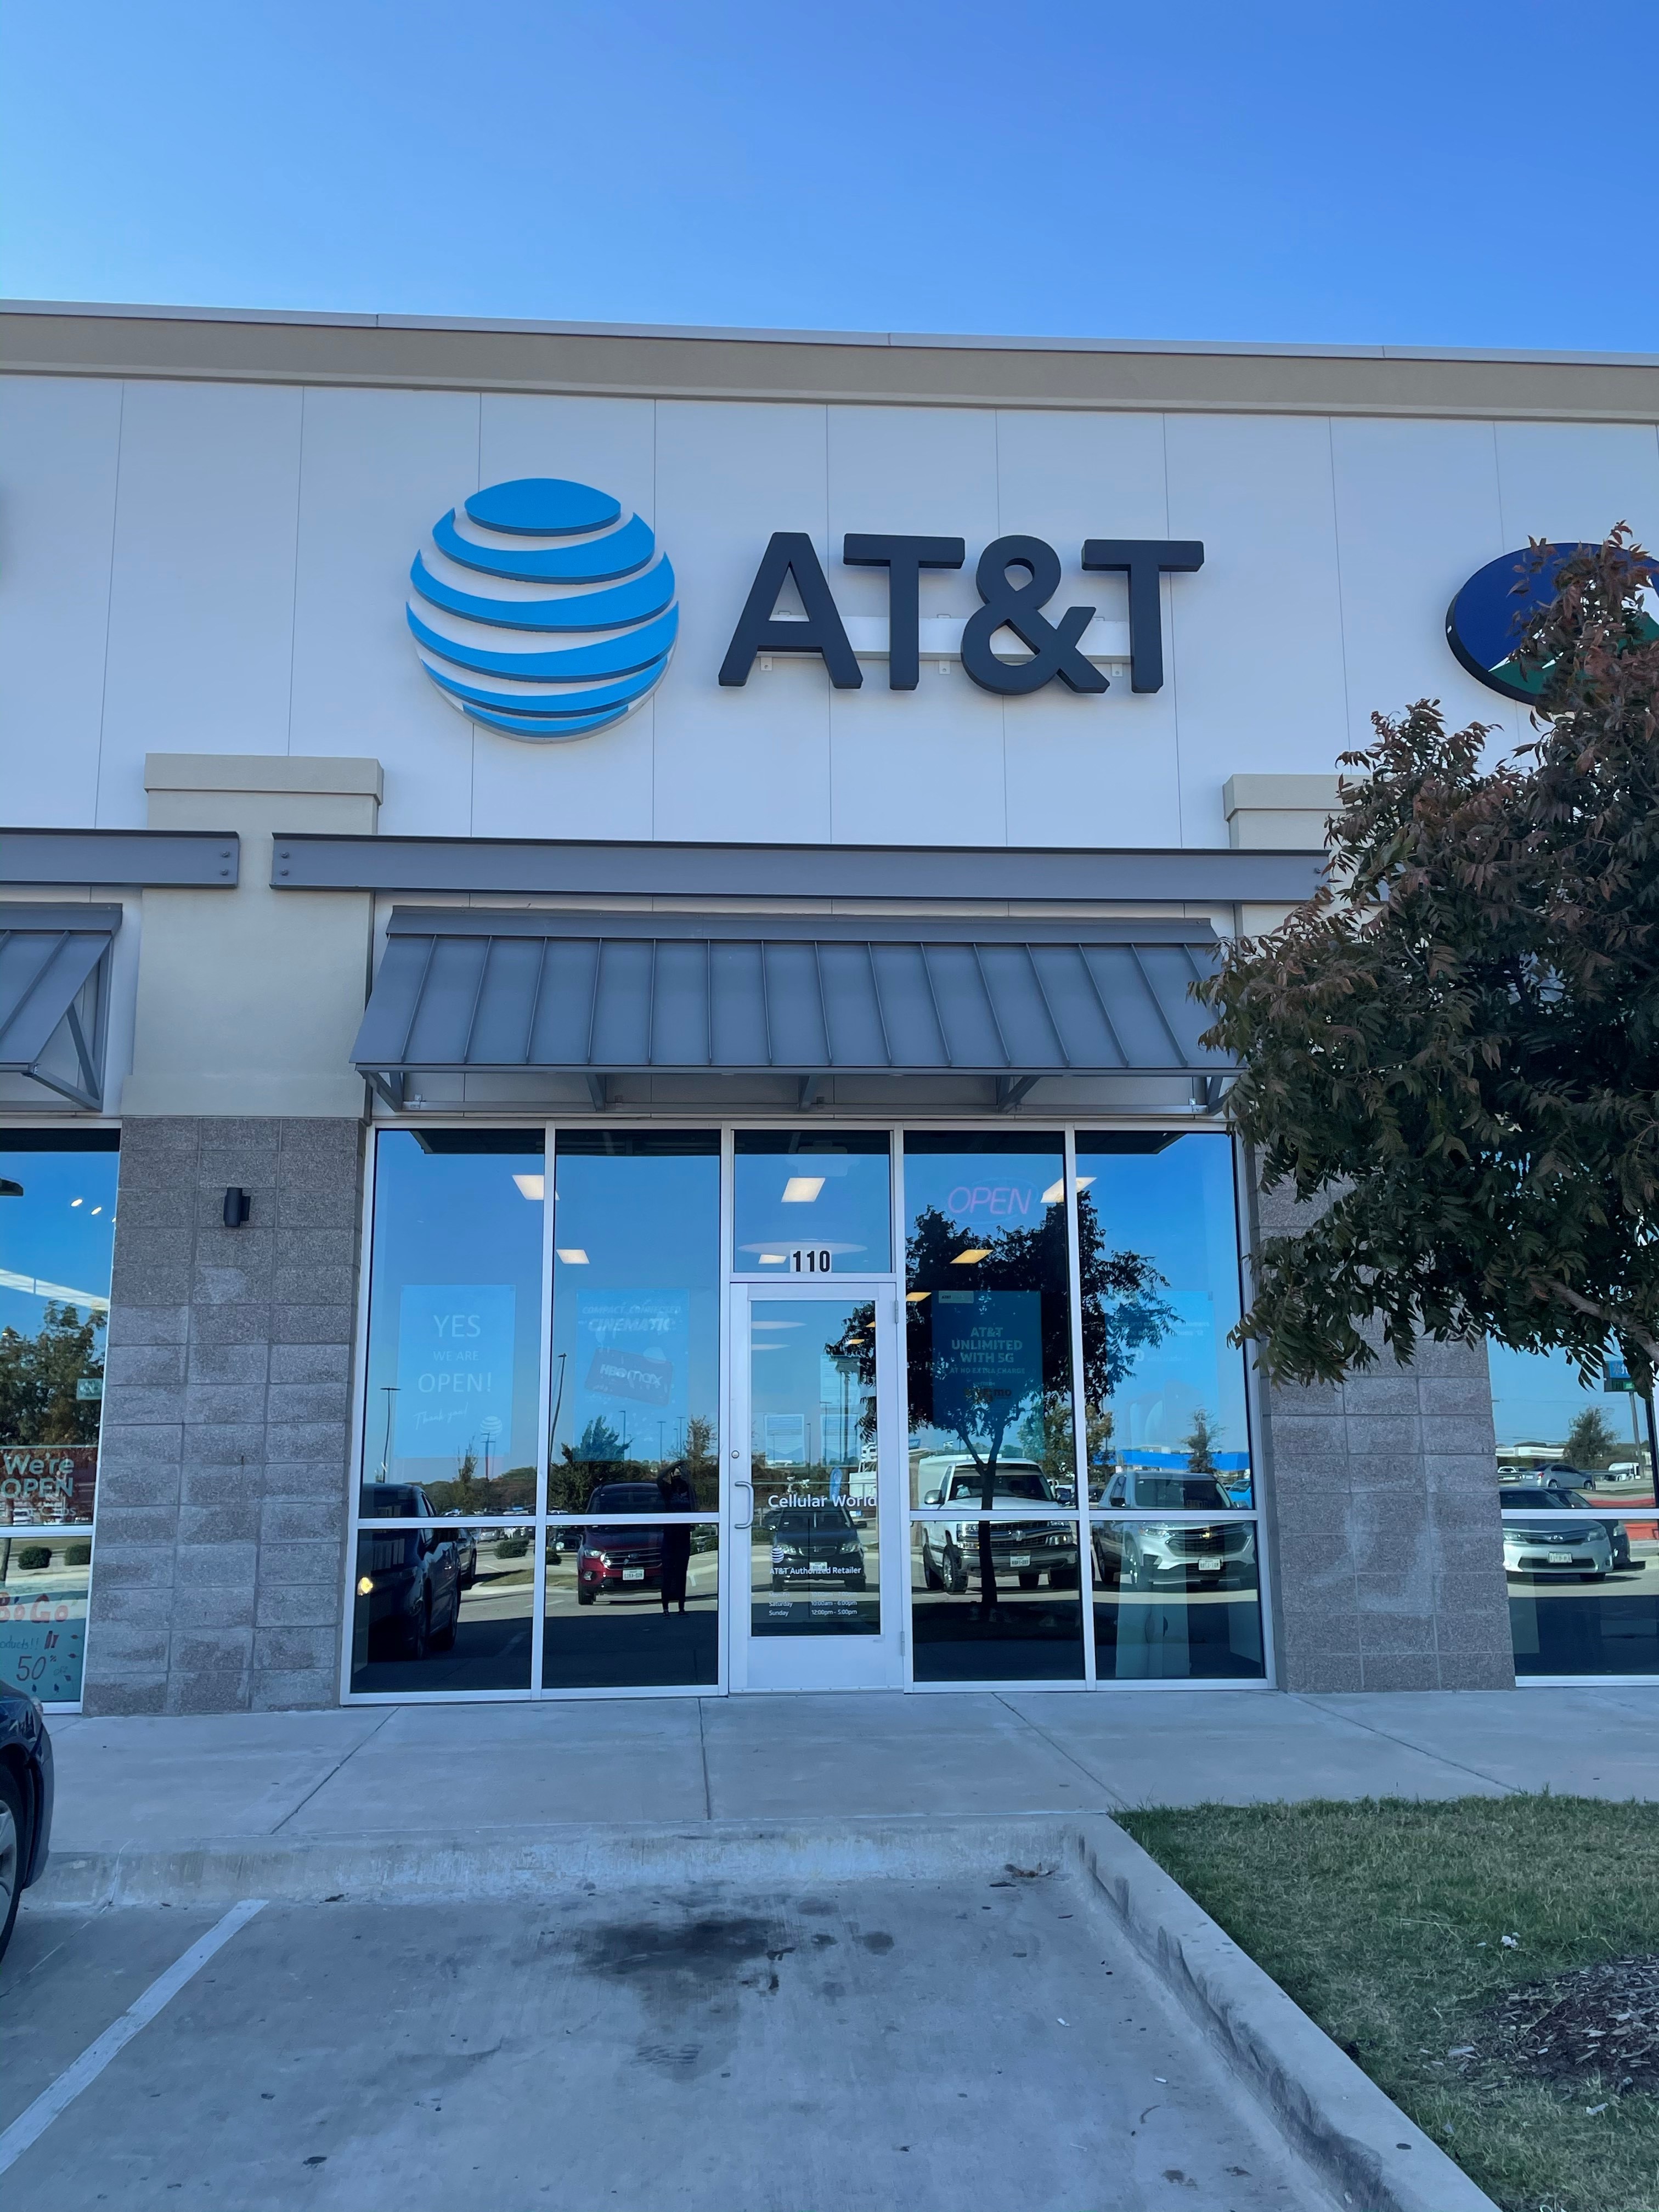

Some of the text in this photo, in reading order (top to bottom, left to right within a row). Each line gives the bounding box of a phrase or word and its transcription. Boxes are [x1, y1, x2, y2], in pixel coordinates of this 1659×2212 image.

[718, 531, 1205, 696] AT&T
[948, 1186, 1032, 1215] OPEN
[793, 1250, 830, 1272] 110
[433, 1314, 481, 1338] YES
[970, 1327, 1003, 1338] AT&T
[433, 1351, 479, 1361] WE ARE
[951, 1340, 1023, 1351] UNLIMITED
[960, 1352, 1014, 1363] WITH 5G
[418, 1372, 492, 1393] OPEN!
[413, 1408, 443, 1430] Thank
[3, 1452, 75, 1475] We're
[1, 1477, 74, 1499] OPEN
[768, 1494, 877, 1508] Cellular World
